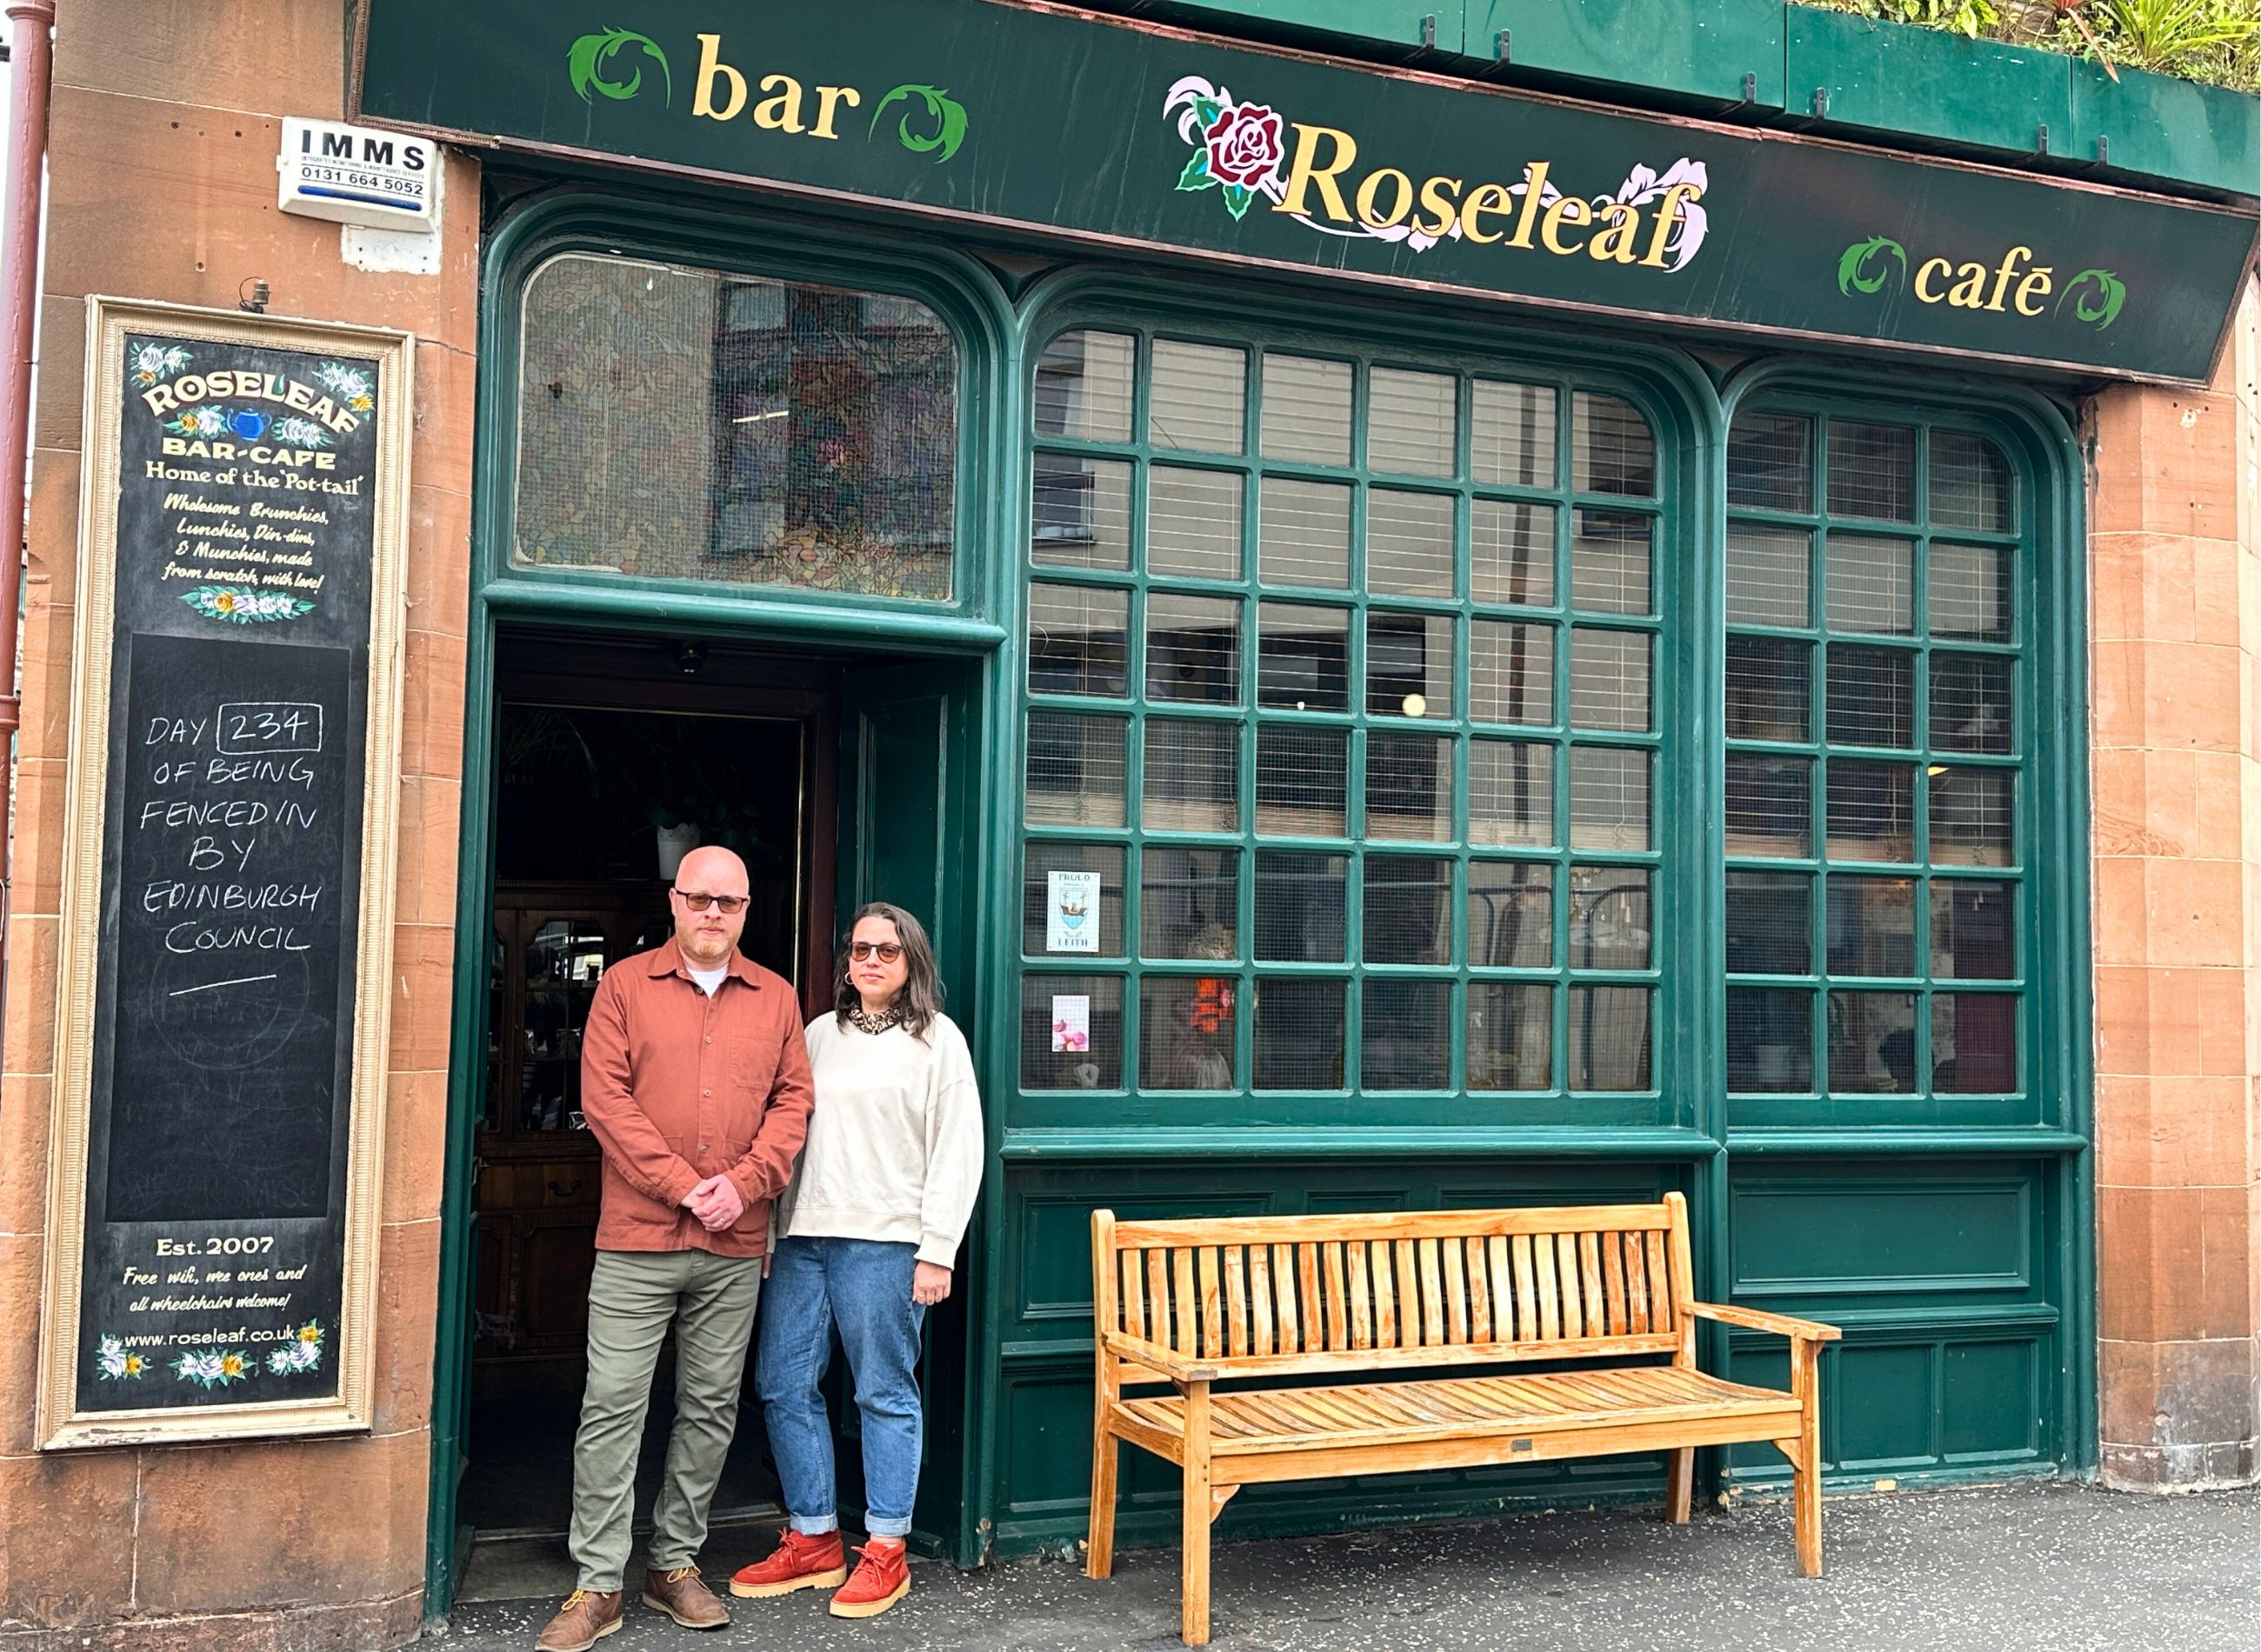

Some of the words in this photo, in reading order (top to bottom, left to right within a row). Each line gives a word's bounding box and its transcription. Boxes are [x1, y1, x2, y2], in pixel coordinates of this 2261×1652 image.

[692, 33, 861, 140] bar
[301, 129, 425, 171] IMMS
[302, 167, 342, 182] 0131
[349, 173, 378, 188] 664
[384, 178, 424, 196] 5052
[1271, 122, 1703, 269] Roseleaf
[142, 370, 360, 434] ROSELEAF
[163, 437, 337, 470] BAR-CAFE
[146, 461, 211, 483] Home
[215, 468, 238, 485] of
[243, 470, 280, 489] the
[163, 493, 241, 516] Wholesome
[250, 502, 330, 525] Brunchies,
[177, 517, 250, 542] Lunchies,
[253, 524, 316, 547] Din-dins,
[175, 540, 190, 556] &
[193, 541, 270, 564] Munchies,
[272, 550, 313, 567] made
[161, 562, 203, 581] from
[262, 571, 293, 587] with
[294, 573, 325, 595] love!
[144, 716, 208, 746] DAY
[229, 709, 309, 742] 234
[153, 761, 197, 785] OF
[206, 757, 315, 790] BEING
[140, 800, 269, 829] FENCED
[275, 799, 318, 829] IN
[189, 836, 257, 873] BY
[143, 879, 323, 913] EDINBURGH
[165, 921, 311, 954] COUNCIL
[156, 1238, 203, 1257] Est.
[205, 1236, 275, 1256] 2007
[123, 1266, 158, 1285] Free
[205, 1271, 231, 1283] wee
[237, 1269, 269, 1282] ones
[276, 1263, 308, 1281] and
[130, 1296, 150, 1312] all
[150, 1294, 233, 1311] wheelchairs
[235, 1293, 292, 1312] welcome!
[124, 1323, 296, 1347] www.roseleaf.co.uk
